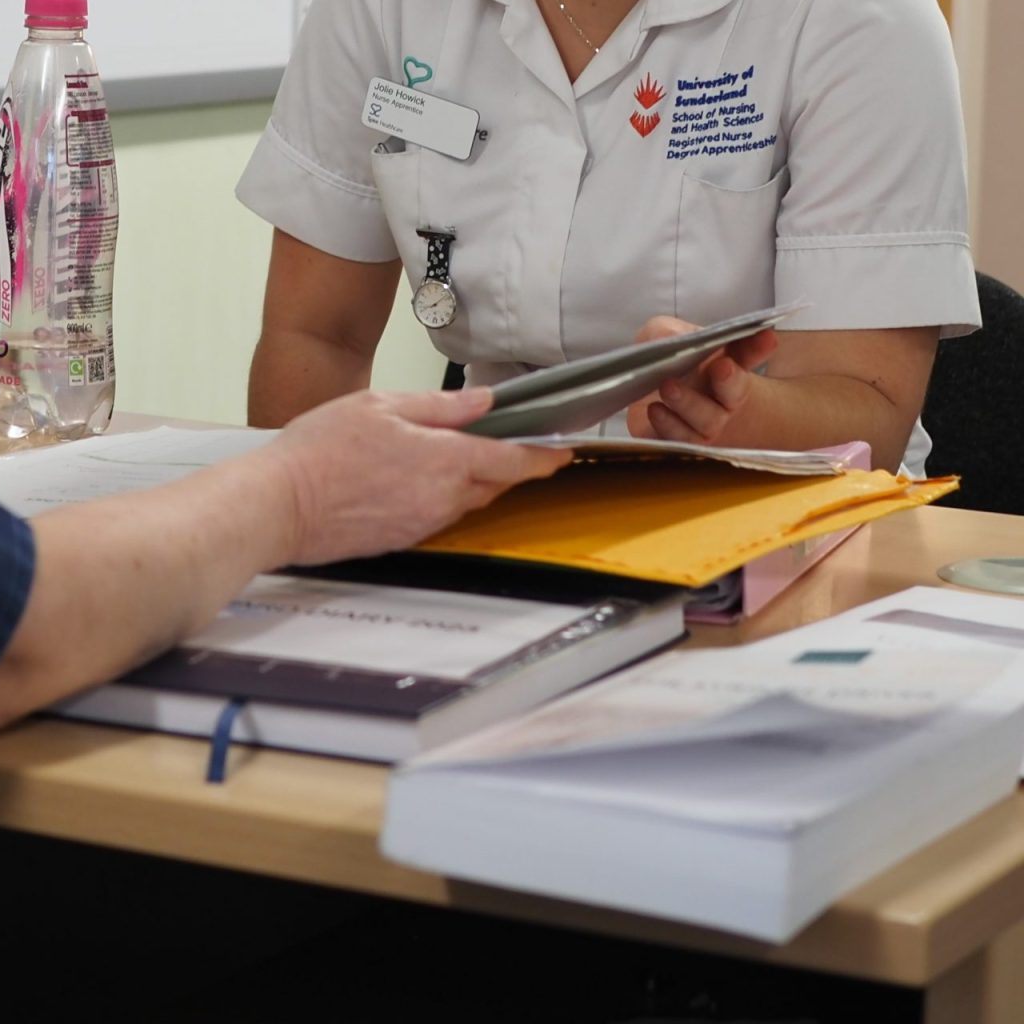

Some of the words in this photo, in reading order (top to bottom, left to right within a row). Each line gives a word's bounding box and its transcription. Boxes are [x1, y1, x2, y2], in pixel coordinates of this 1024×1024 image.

[677, 72, 739, 91] University
[741, 64, 754, 80] of
[372, 92, 390, 105] Nurse
[391, 100, 423, 116] Apprentice
[374, 82, 394, 96] Jolie
[396, 88, 426, 107] Howick
[675, 84, 748, 107] Sunderland
[671, 124, 688, 135] and
[691, 120, 719, 133] Health
[723, 113, 764, 127] Sciences
[672, 111, 704, 123] School
[706, 108, 717, 119] of
[718, 103, 756, 115] Nursing
[668, 133, 720, 150] Registered
[722, 131, 753, 141] Nurse
[1, 279, 11, 322] ZERO
